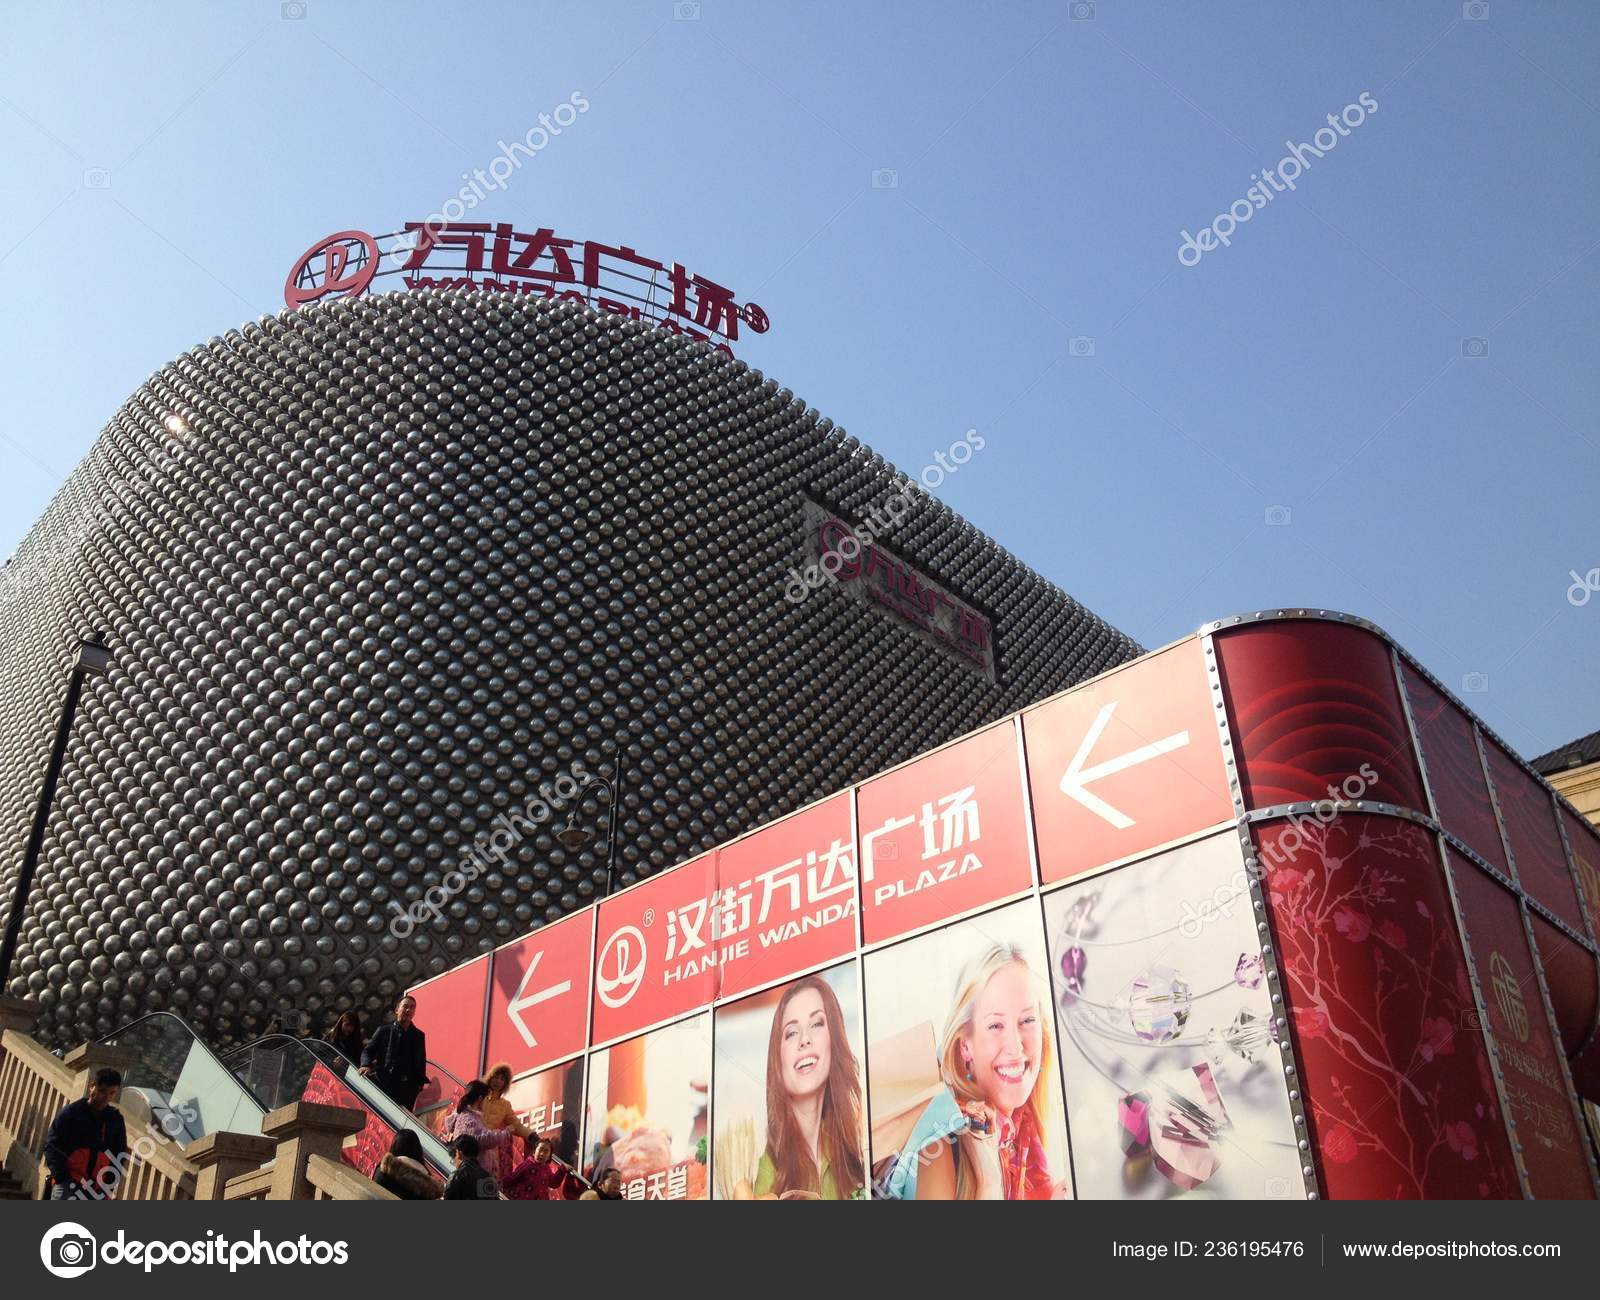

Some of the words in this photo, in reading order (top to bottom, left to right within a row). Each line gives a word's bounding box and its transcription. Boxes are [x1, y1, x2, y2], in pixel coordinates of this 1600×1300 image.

[403, 222, 738, 341] 万达广场
[663, 941, 749, 986] HANJIE
[758, 903, 864, 948] WANDA
[874, 852, 983, 906] PLAZA
[664, 785, 982, 961] 汉街万达广场
